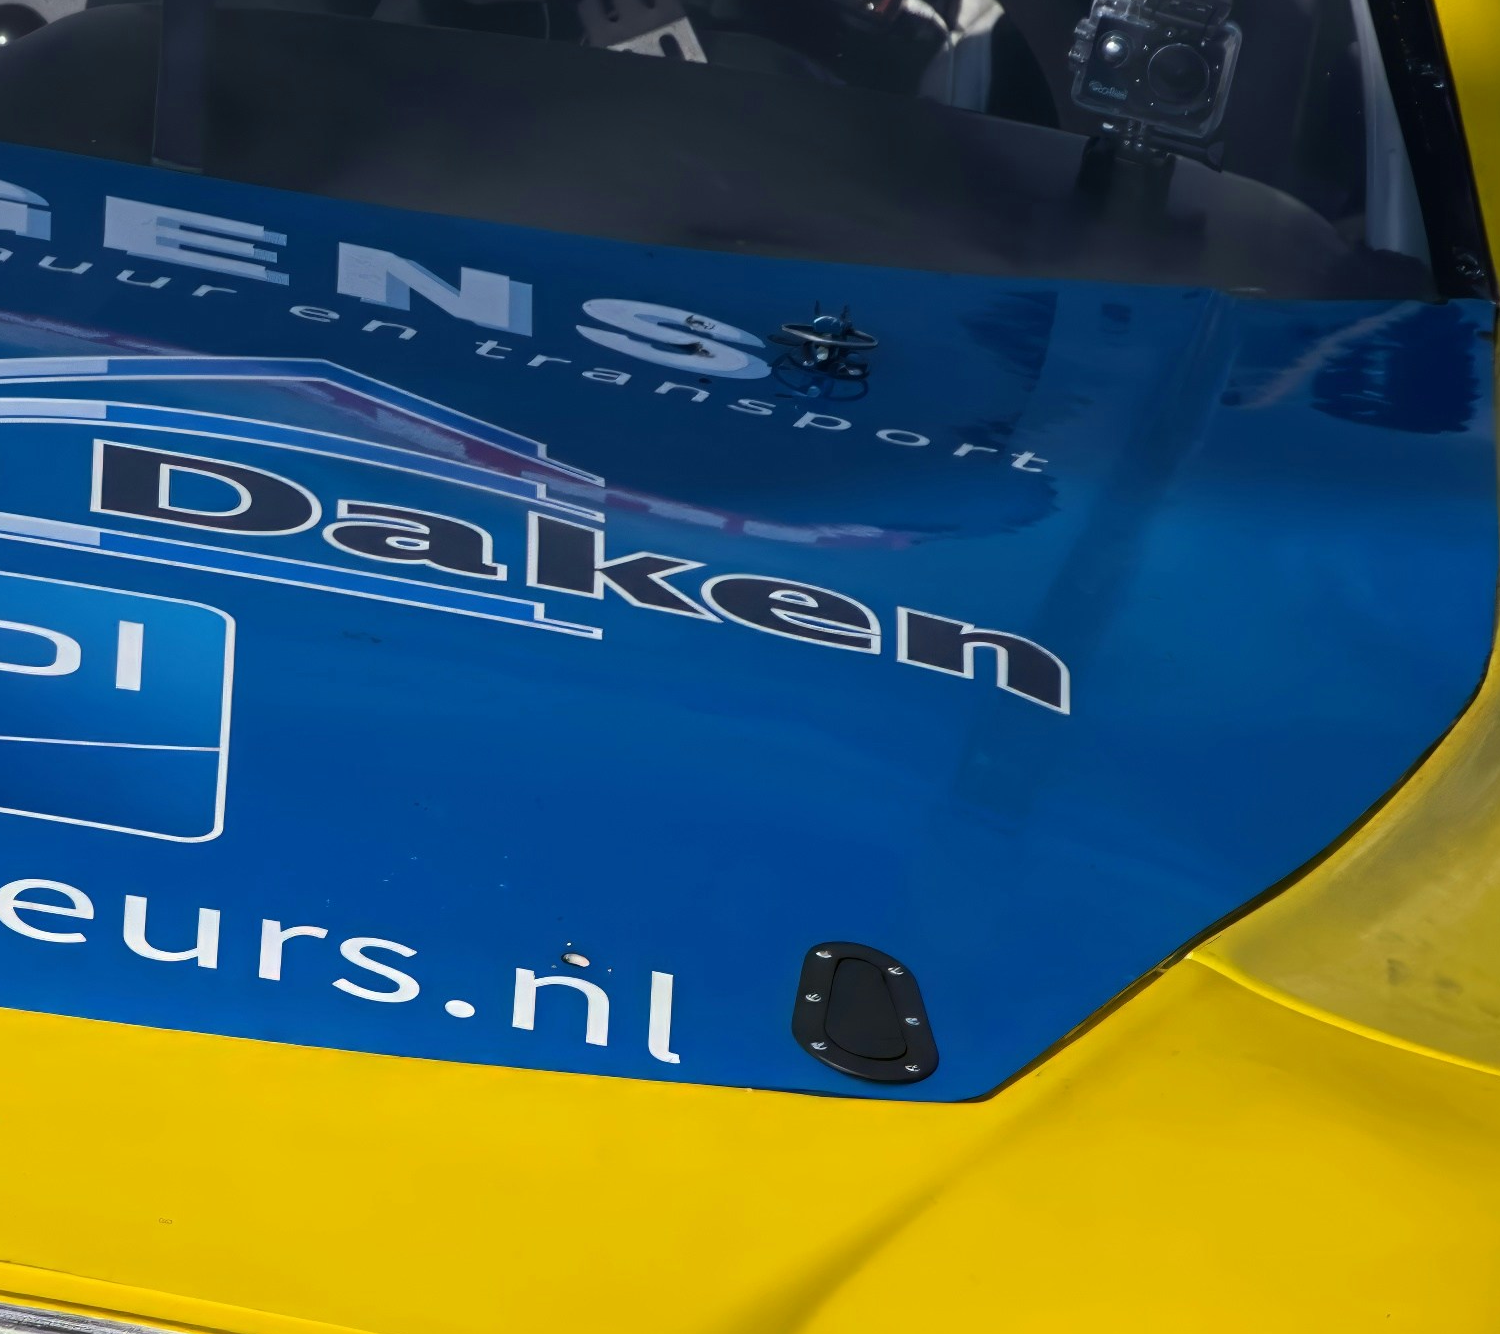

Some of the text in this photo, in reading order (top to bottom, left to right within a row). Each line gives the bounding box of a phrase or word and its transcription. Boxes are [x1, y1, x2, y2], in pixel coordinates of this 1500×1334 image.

[289, 302, 416, 343] en
[476, 336, 1050, 475] transport
[89, 438, 1071, 714] Daken
